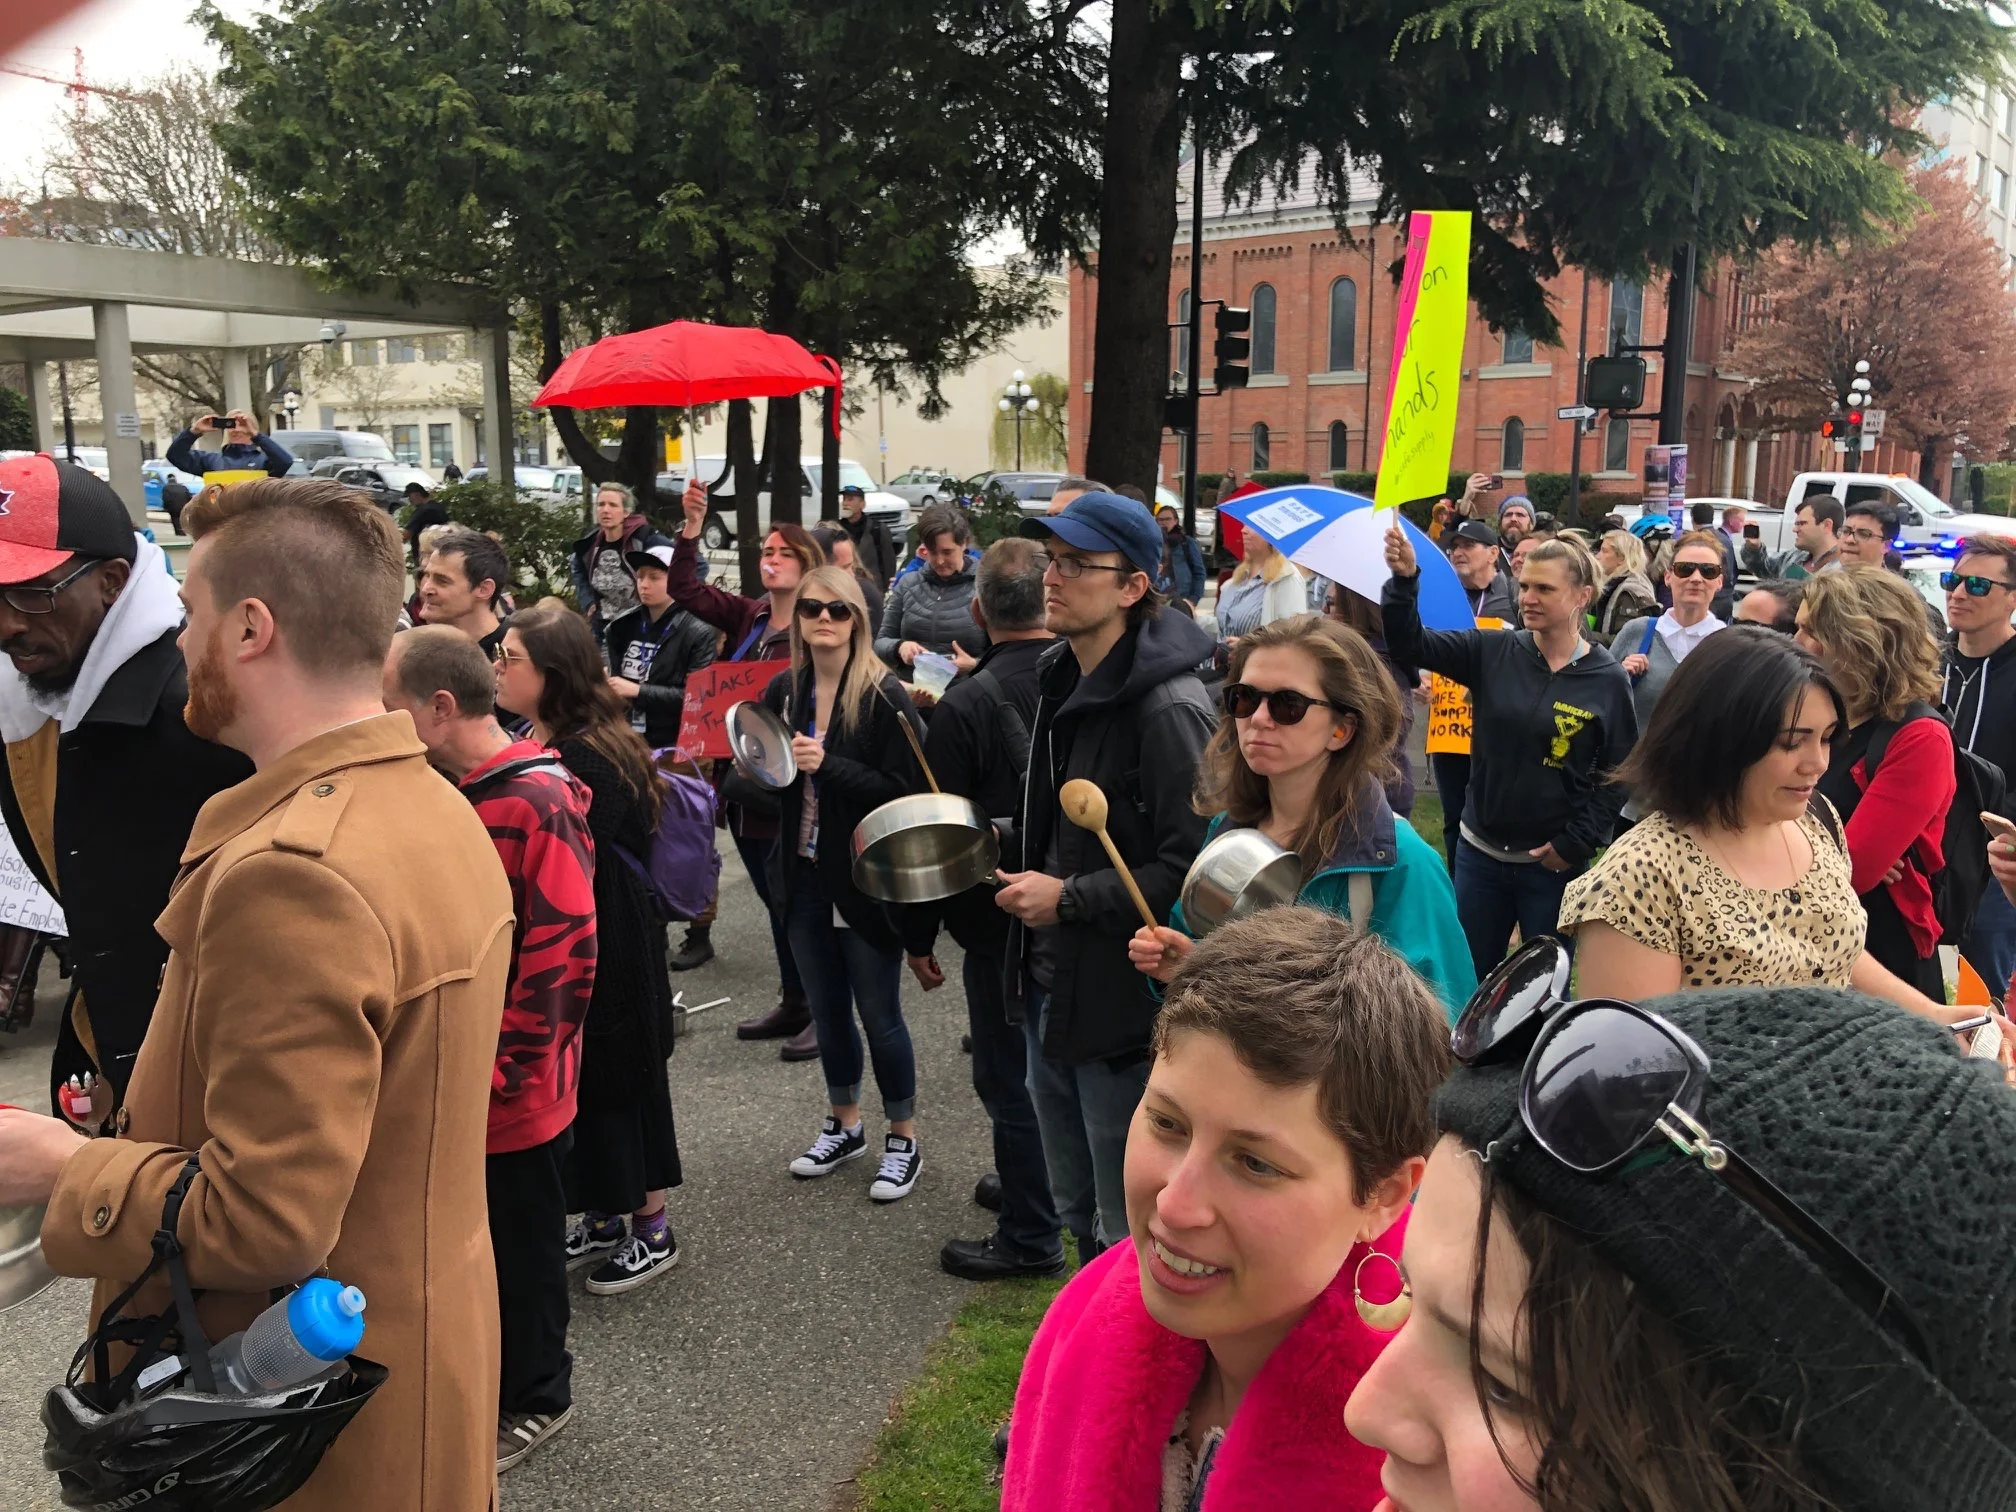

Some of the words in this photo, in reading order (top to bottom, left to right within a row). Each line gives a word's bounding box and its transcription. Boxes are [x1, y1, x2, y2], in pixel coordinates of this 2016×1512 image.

[1422, 265, 1448, 291] on
[1866, 411, 1881, 420] ONE
[1865, 421, 1880, 429] WAY
